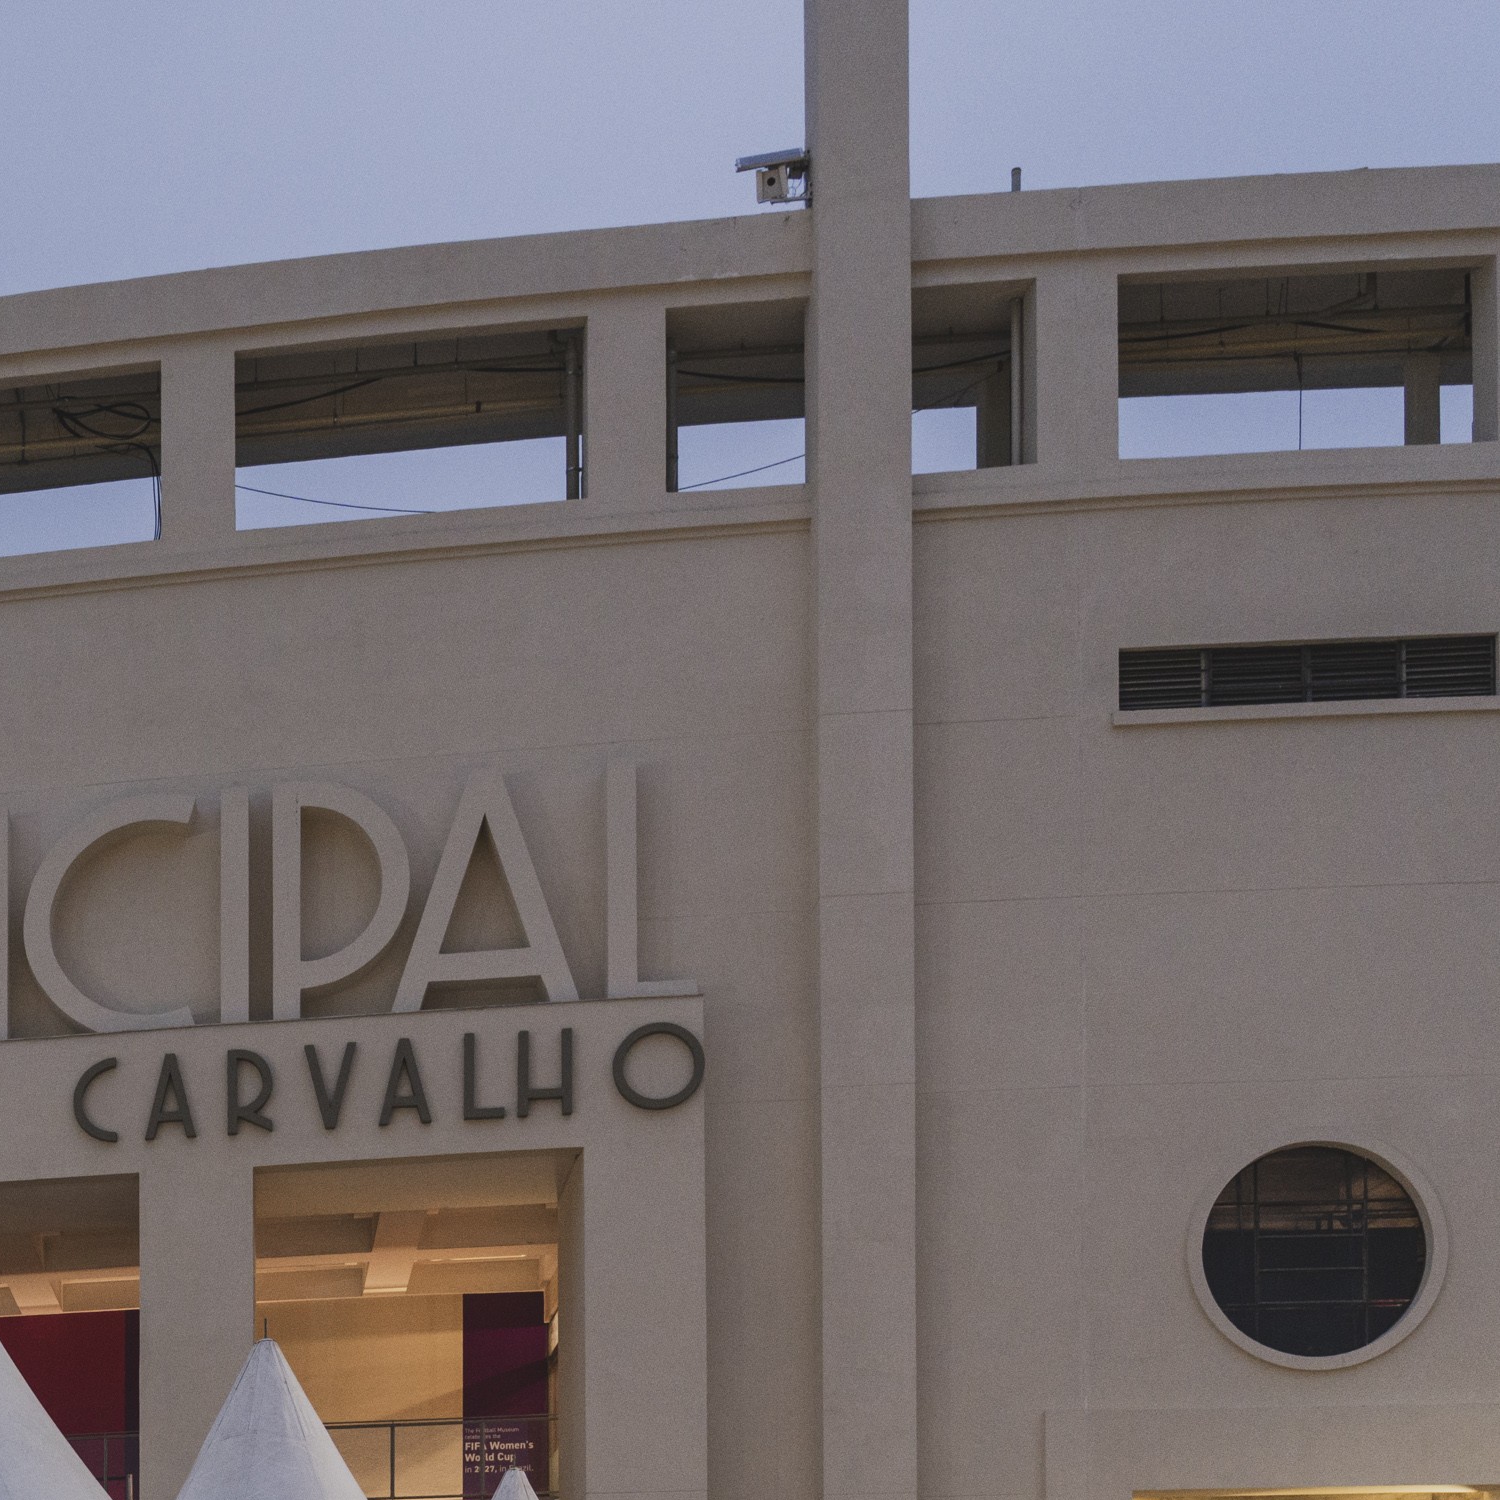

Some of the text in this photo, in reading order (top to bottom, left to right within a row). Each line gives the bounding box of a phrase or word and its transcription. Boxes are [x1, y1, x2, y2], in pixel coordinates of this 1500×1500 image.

[72, 1021, 705, 1142] CARVALHO
[489, 1440, 534, 1450] Women's
[465, 1452, 495, 1462] Wold
[474, 1465, 498, 1474] 227,
